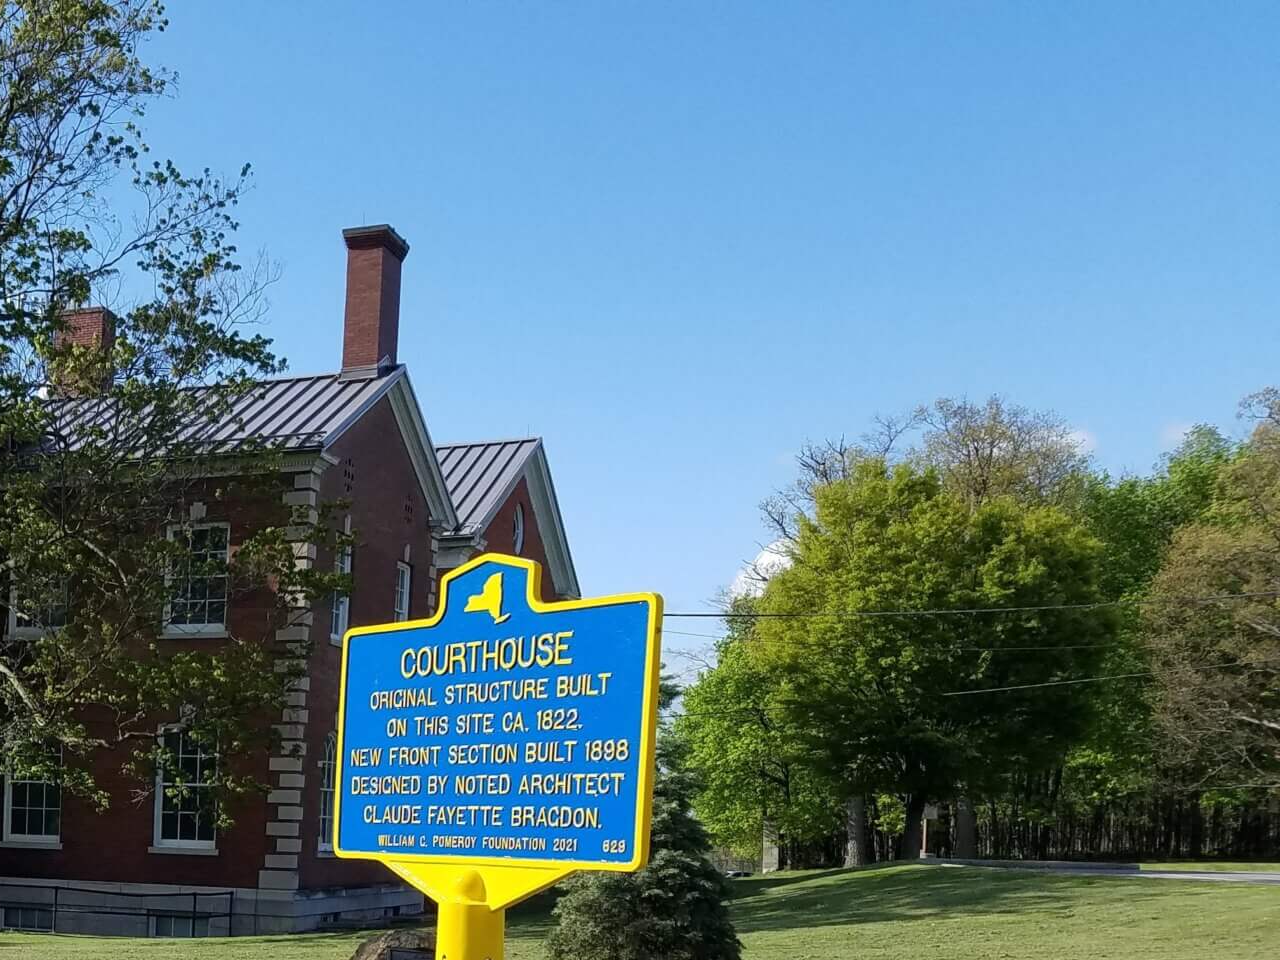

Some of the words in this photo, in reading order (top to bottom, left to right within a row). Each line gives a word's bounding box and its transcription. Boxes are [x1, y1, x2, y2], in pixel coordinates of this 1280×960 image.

[401, 630, 574, 679] COURTHOUSE
[371, 688, 437, 710] ORIGINAL
[445, 678, 548, 704] STRUCTURE
[557, 673, 611, 697] BUILT
[387, 718, 406, 737] ON
[414, 716, 448, 735] THIS
[456, 714, 494, 734] SITE
[503, 712, 529, 733] CA.
[537, 709, 582, 730] 1822.
[351, 748, 381, 766] NEW
[390, 746, 441, 767] FRONT
[448, 744, 517, 764] SECTION
[525, 741, 577, 763] BUILT
[585, 739, 628, 761] 1898
[352, 776, 420, 794] DESIGNED
[428, 776, 448, 794] BY
[455, 774, 510, 795] NOTED
[519, 773, 624, 797] ARCHITECT
[364, 805, 421, 823] CLAUDE
[428, 806, 503, 825] FAYETTE
[511, 806, 601, 828] BRAGDON.
[378, 835, 414, 846] WILLIAM
[433, 836, 476, 848] POMEROY
[483, 837, 545, 850] FOUNDATION
[553, 838, 577, 851] 2021
